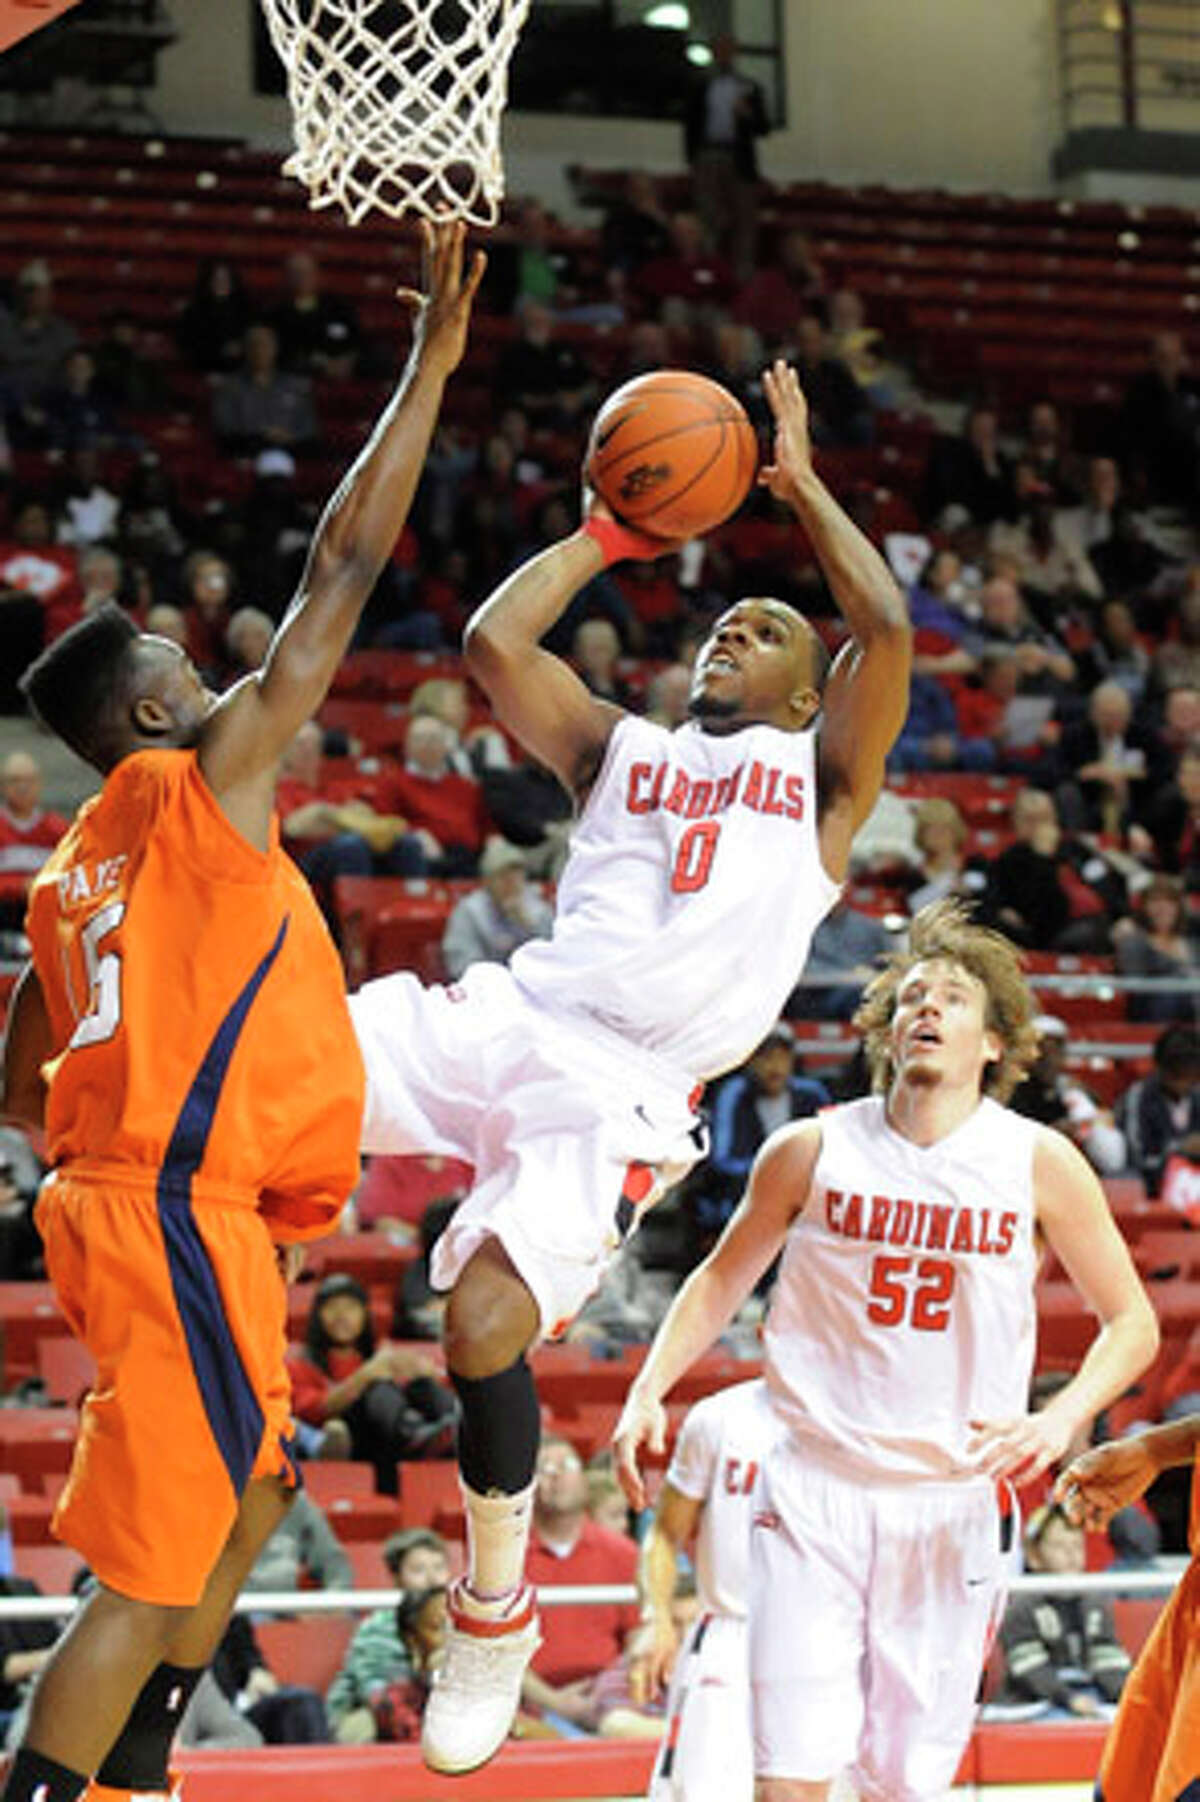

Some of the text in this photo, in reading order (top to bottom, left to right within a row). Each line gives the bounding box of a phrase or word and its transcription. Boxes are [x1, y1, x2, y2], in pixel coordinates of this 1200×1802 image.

[669, 819, 721, 894] 0
[825, 1188, 1019, 1255] CARDINALS
[866, 1254, 956, 1332] 52
